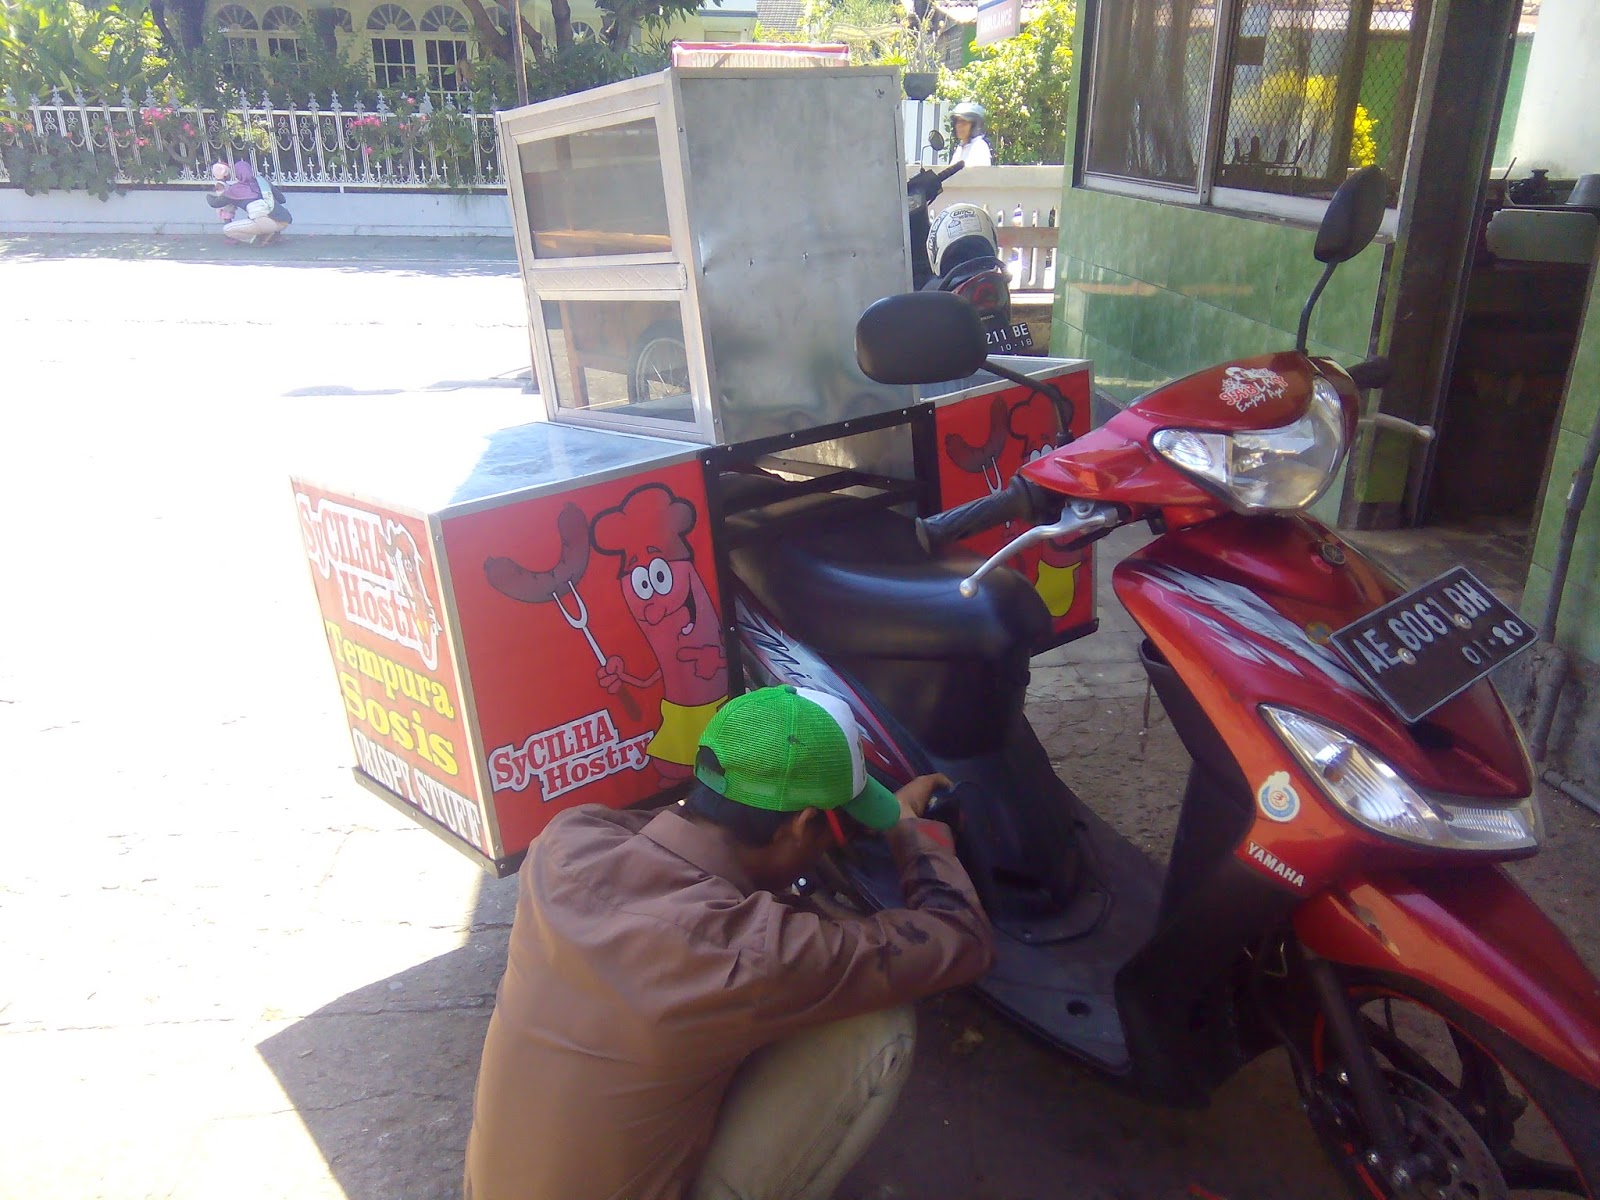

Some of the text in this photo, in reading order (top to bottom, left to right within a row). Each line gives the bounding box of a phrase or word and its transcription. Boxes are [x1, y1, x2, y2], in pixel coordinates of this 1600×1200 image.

[1012, 323, 1029, 338] BE
[300, 500, 395, 579] SyCILHA
[1353, 579, 1492, 674] AE 6061 BH
[325, 619, 455, 719] Tempura
[340, 671, 458, 776] Sosis
[493, 715, 614, 786] SyCILHA
[352, 727, 482, 848] CRISPY STUFF
[543, 736, 650, 795] Hostry
[1247, 841, 1305, 887] YAMAHA
